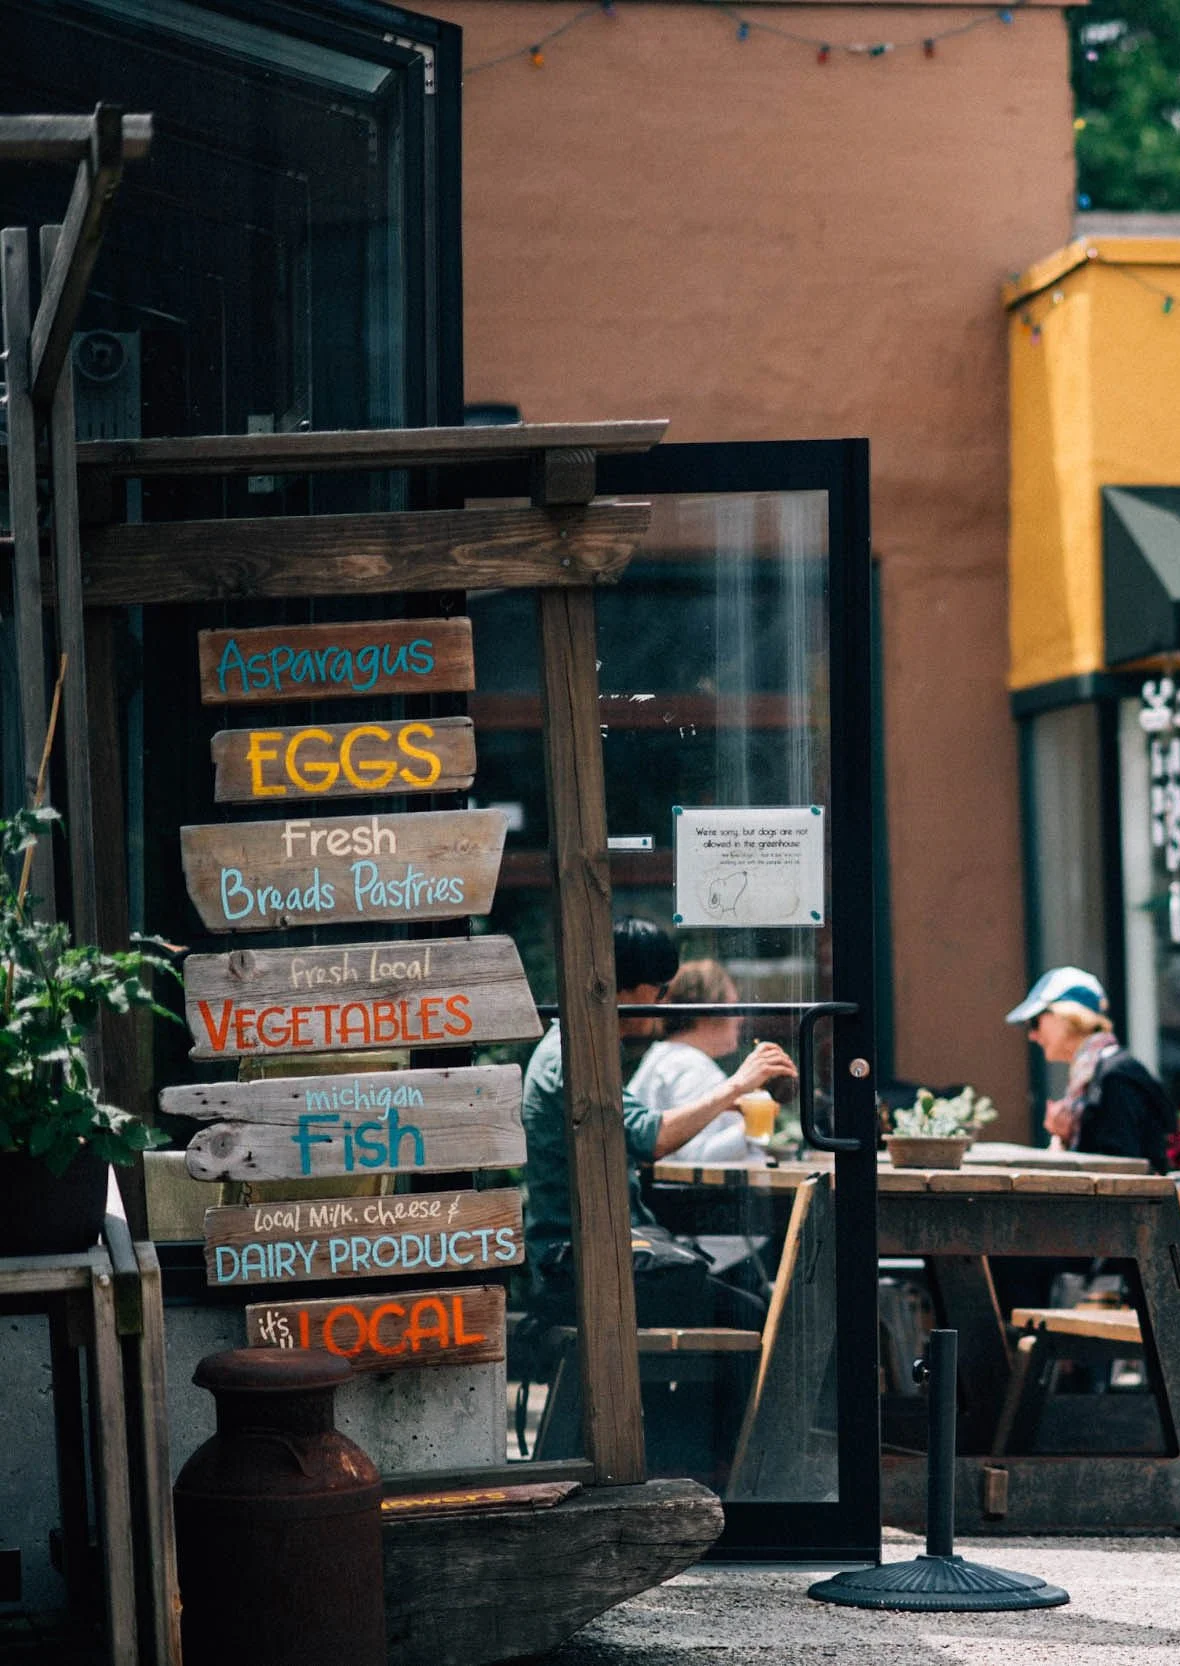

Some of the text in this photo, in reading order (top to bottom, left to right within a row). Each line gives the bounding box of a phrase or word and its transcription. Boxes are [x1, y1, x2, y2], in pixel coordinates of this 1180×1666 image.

[216, 638, 436, 693] Asparagus
[246, 722, 442, 797] EGGS
[281, 816, 397, 858] Fresh
[703, 840, 732, 848] allowed
[744, 840, 755, 848] the
[759, 840, 800, 850] greenhouse
[742, 827, 755, 836] but
[759, 828, 777, 839] dogs
[796, 828, 808, 836] not
[221, 860, 465, 920] Breads Pastries
[197, 994, 473, 1052] VEGETABLES
[305, 1079, 424, 1120] michigan
[290, 1107, 426, 1176] Fish
[254, 1205, 300, 1232] Local
[215, 1227, 518, 1282] DAIRY PRODUCTS
